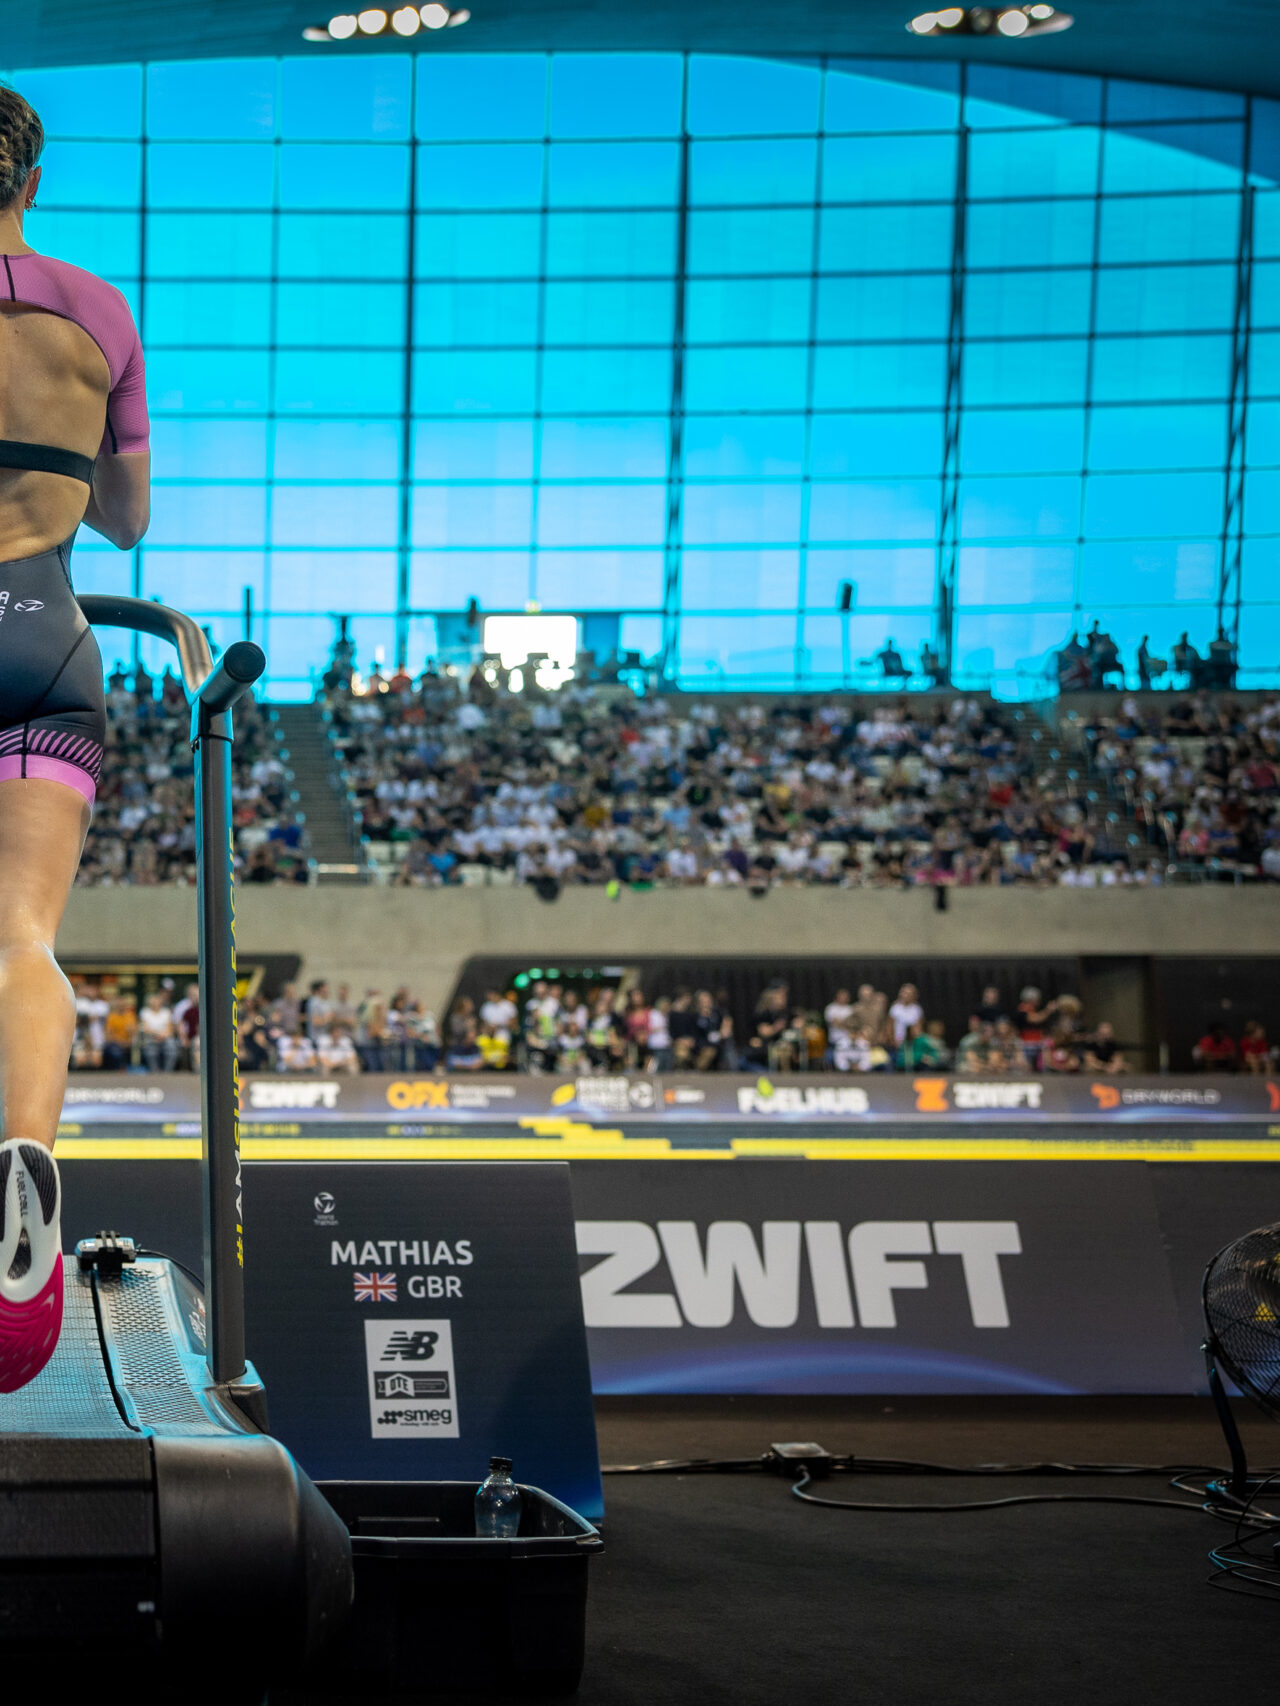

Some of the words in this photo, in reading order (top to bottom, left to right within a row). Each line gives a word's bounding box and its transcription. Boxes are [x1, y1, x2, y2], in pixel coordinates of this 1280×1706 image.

[331, 1239, 474, 1266] MATHIAS
[407, 1275, 463, 1299] GBR
[575, 1220, 1022, 1329] ZWIFT
[404, 1408, 452, 1425] smeg
